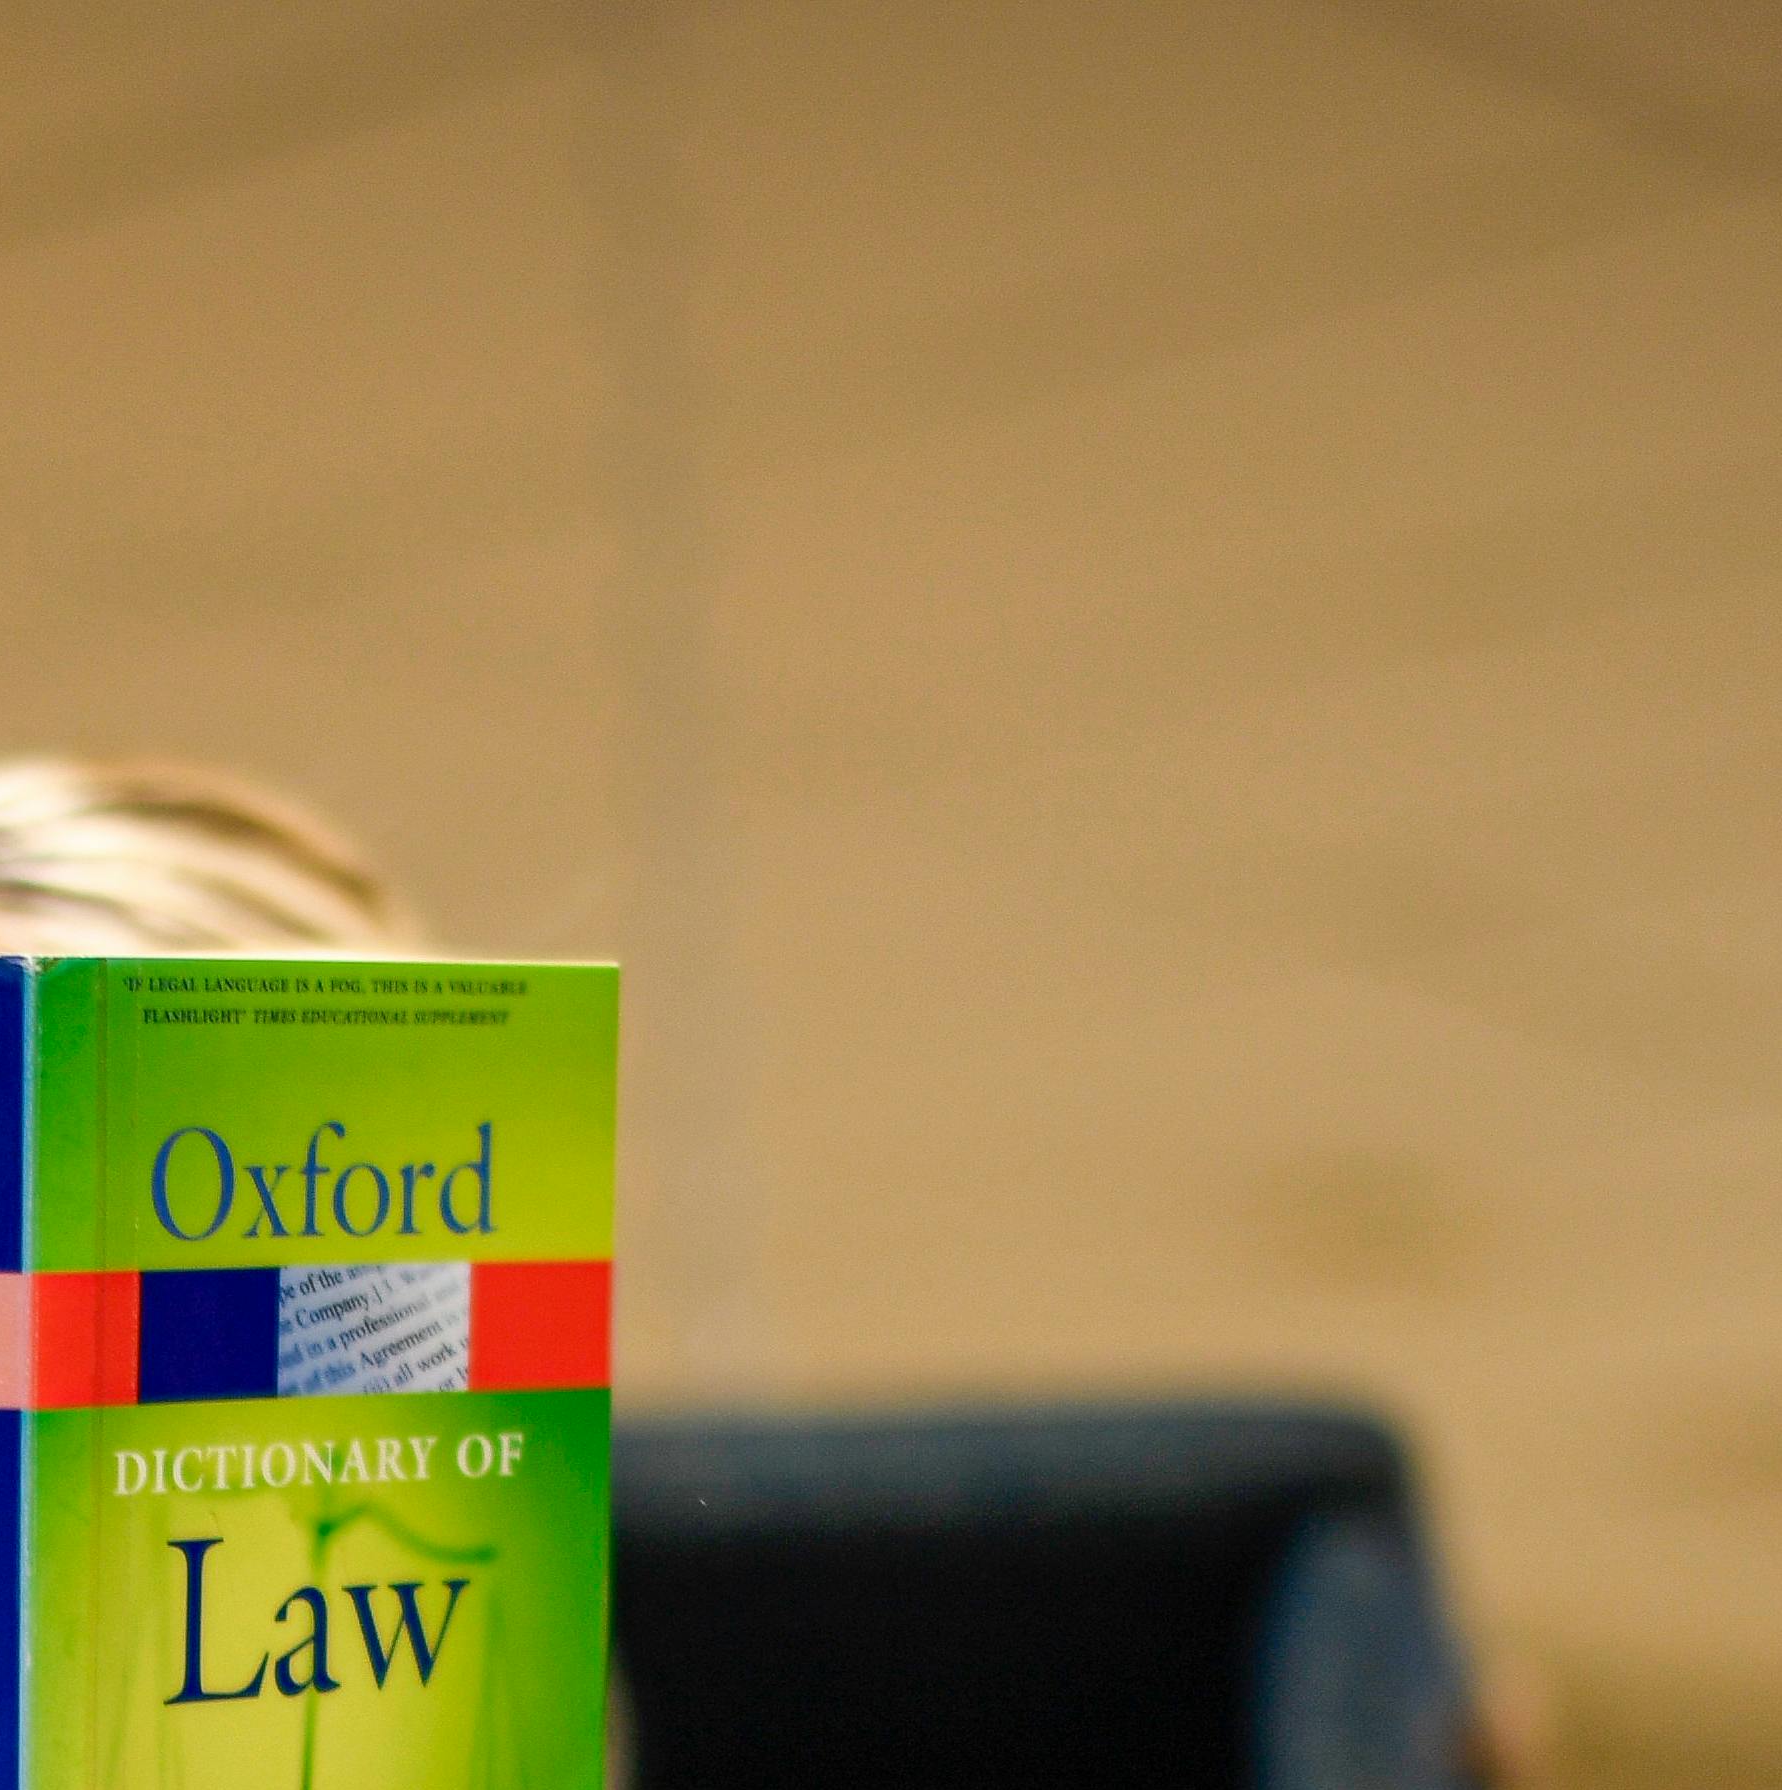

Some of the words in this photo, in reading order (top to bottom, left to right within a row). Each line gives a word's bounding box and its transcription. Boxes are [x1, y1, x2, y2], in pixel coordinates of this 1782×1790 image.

[149, 976, 195, 992] LEGAL
[204, 977, 288, 993] LANGUAGE
[296, 977, 309, 993] IS
[315, 977, 324, 993] A
[373, 977, 408, 993] THIS
[415, 979, 428, 994] IS
[449, 978, 528, 996] VALUABLE
[253, 1007, 296, 1025] TIMES
[301, 1008, 408, 1025] EDUCATIONAL
[414, 1009, 511, 1025] SUPPLEMENT
[150, 1119, 498, 1243] Oxford
[299, 1273, 318, 1297] of
[317, 1270, 344, 1290] the
[295, 1293, 369, 1328] Company
[338, 1294, 433, 1351] professional
[359, 1320, 443, 1370] Agreement
[393, 1362, 415, 1387] all
[417, 1342, 458, 1373] work
[114, 1434, 438, 1497] DICTIONARY
[456, 1432, 525, 1480] OF
[161, 1536, 472, 1707] Law
